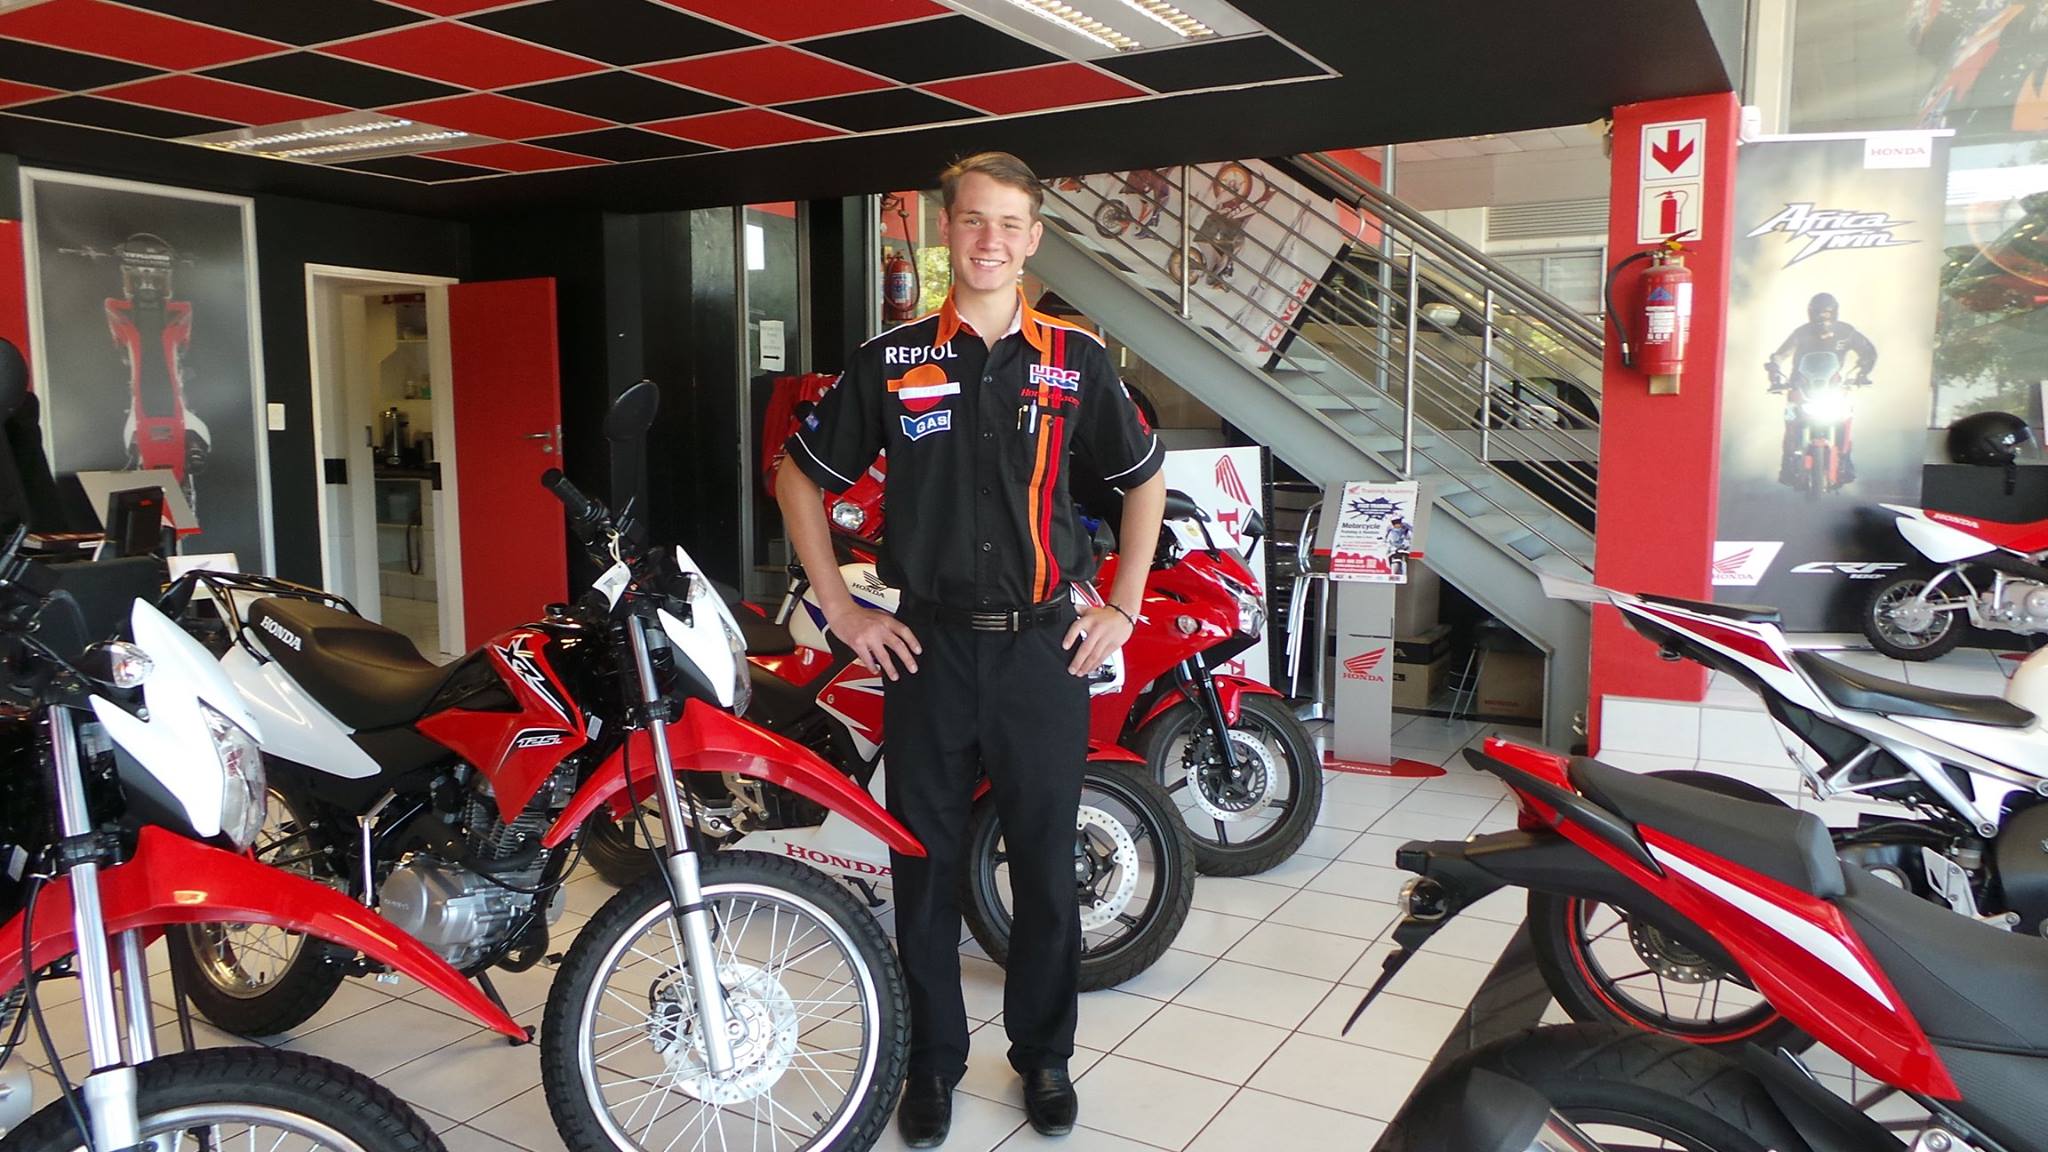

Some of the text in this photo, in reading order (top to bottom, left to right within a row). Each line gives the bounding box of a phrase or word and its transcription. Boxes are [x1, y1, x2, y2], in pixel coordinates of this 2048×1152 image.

[1870, 147, 1925, 156] HONDA
[1746, 202, 1916, 244] Africa
[1781, 229, 1922, 270] Twin
[885, 342, 958, 364] REPSOL
[1029, 364, 1081, 392] HRC
[916, 415, 948, 433] GAS
[1932, 512, 1980, 529] HONDA
[1790, 561, 1908, 574] CRF
[852, 582, 886, 599] HONDA
[260, 615, 302, 652] HONDA
[1342, 672, 1385, 683] HONDA
[784, 842, 892, 877] HONDA
